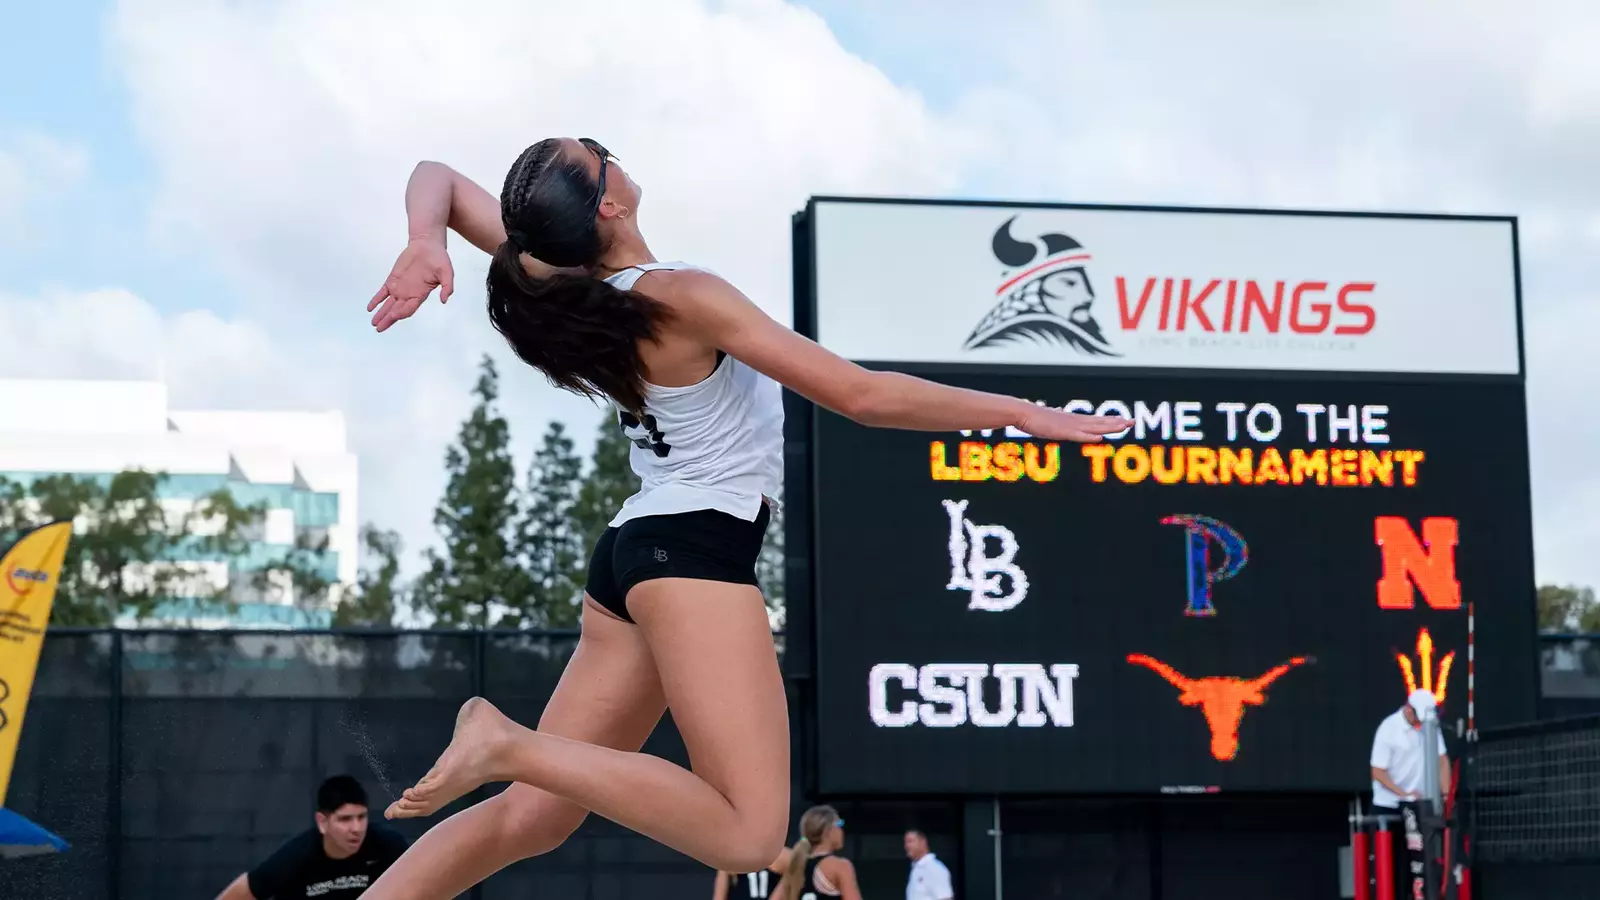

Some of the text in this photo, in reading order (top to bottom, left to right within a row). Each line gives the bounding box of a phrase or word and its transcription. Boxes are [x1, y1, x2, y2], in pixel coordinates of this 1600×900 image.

[1115, 276, 1376, 335] VIKINGS
[1215, 402, 1282, 441] TO
[1296, 403, 1390, 443] THE
[930, 441, 1424, 487] LBSU TOURNAMENT
[941, 499, 1029, 611] LB
[1159, 514, 1248, 616] P
[1375, 515, 1461, 609] N
[868, 663, 1079, 727] CSUN
